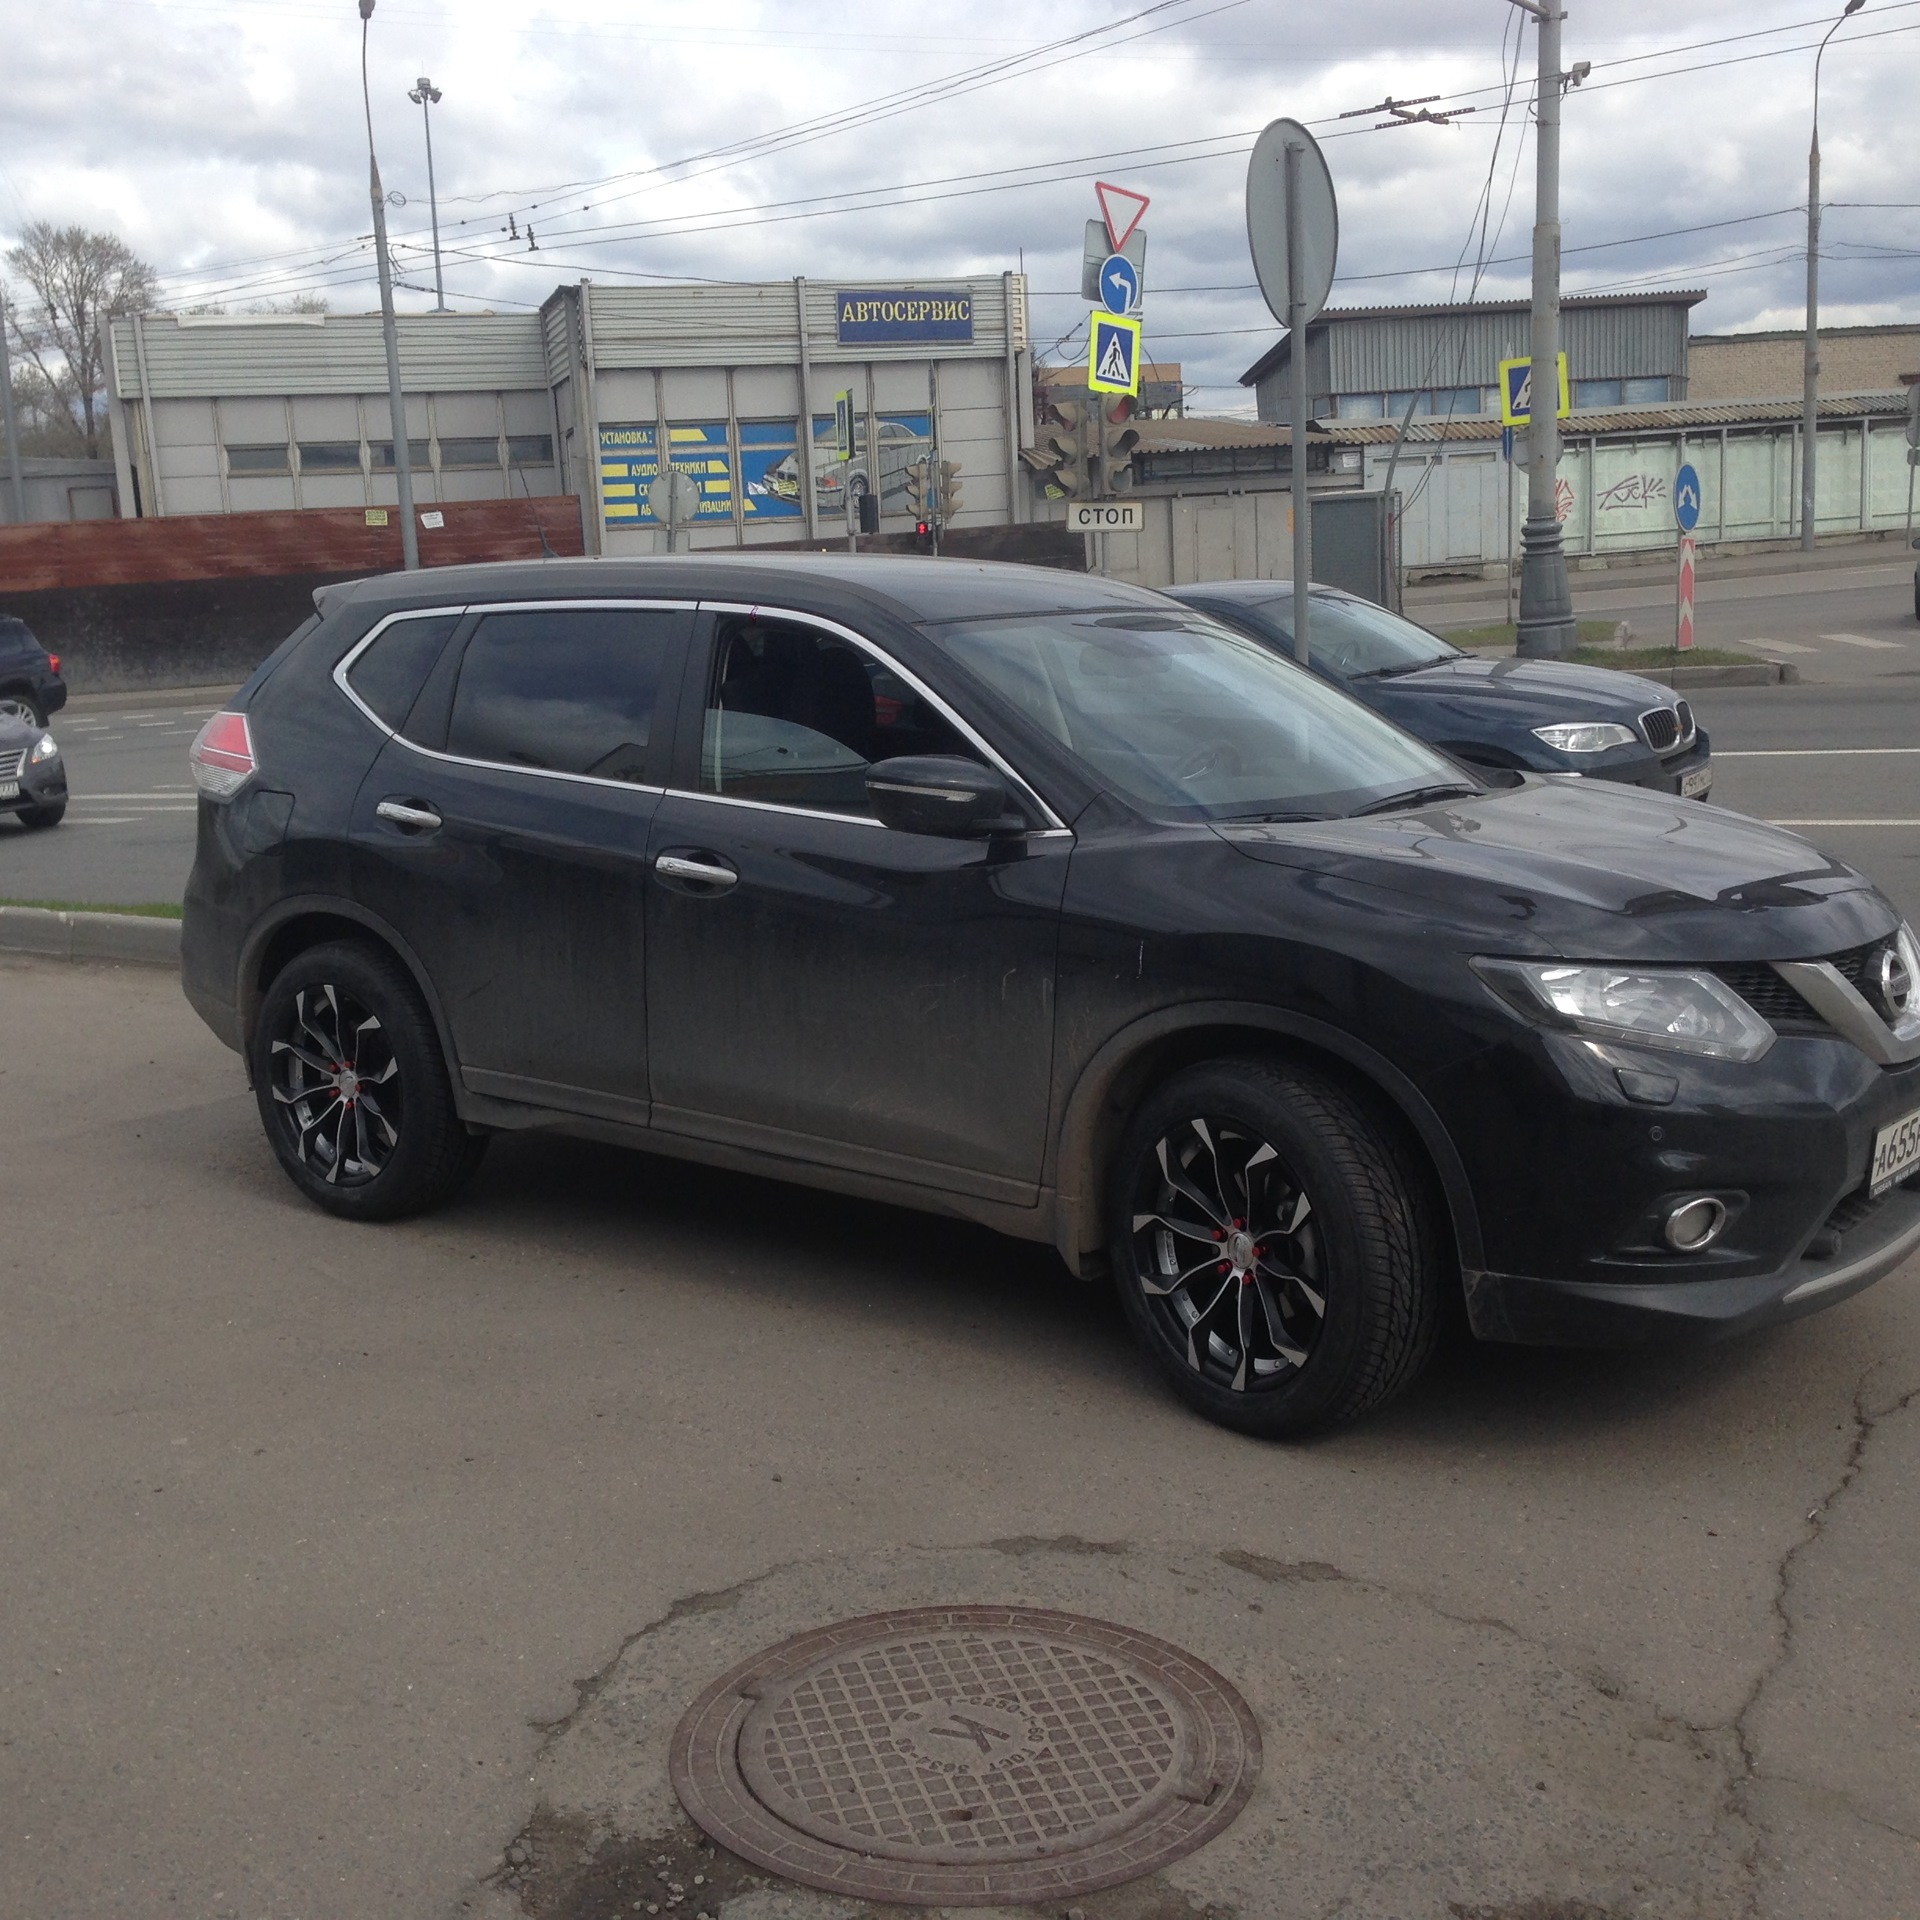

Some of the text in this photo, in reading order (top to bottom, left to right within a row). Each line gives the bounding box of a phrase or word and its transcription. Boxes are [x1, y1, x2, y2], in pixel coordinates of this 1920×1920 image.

[841, 300, 970, 322] АВТОСЕРВИС
[600, 430, 653, 445] УСТАНОВКА:
[1078, 508, 1133, 525] СТОП
